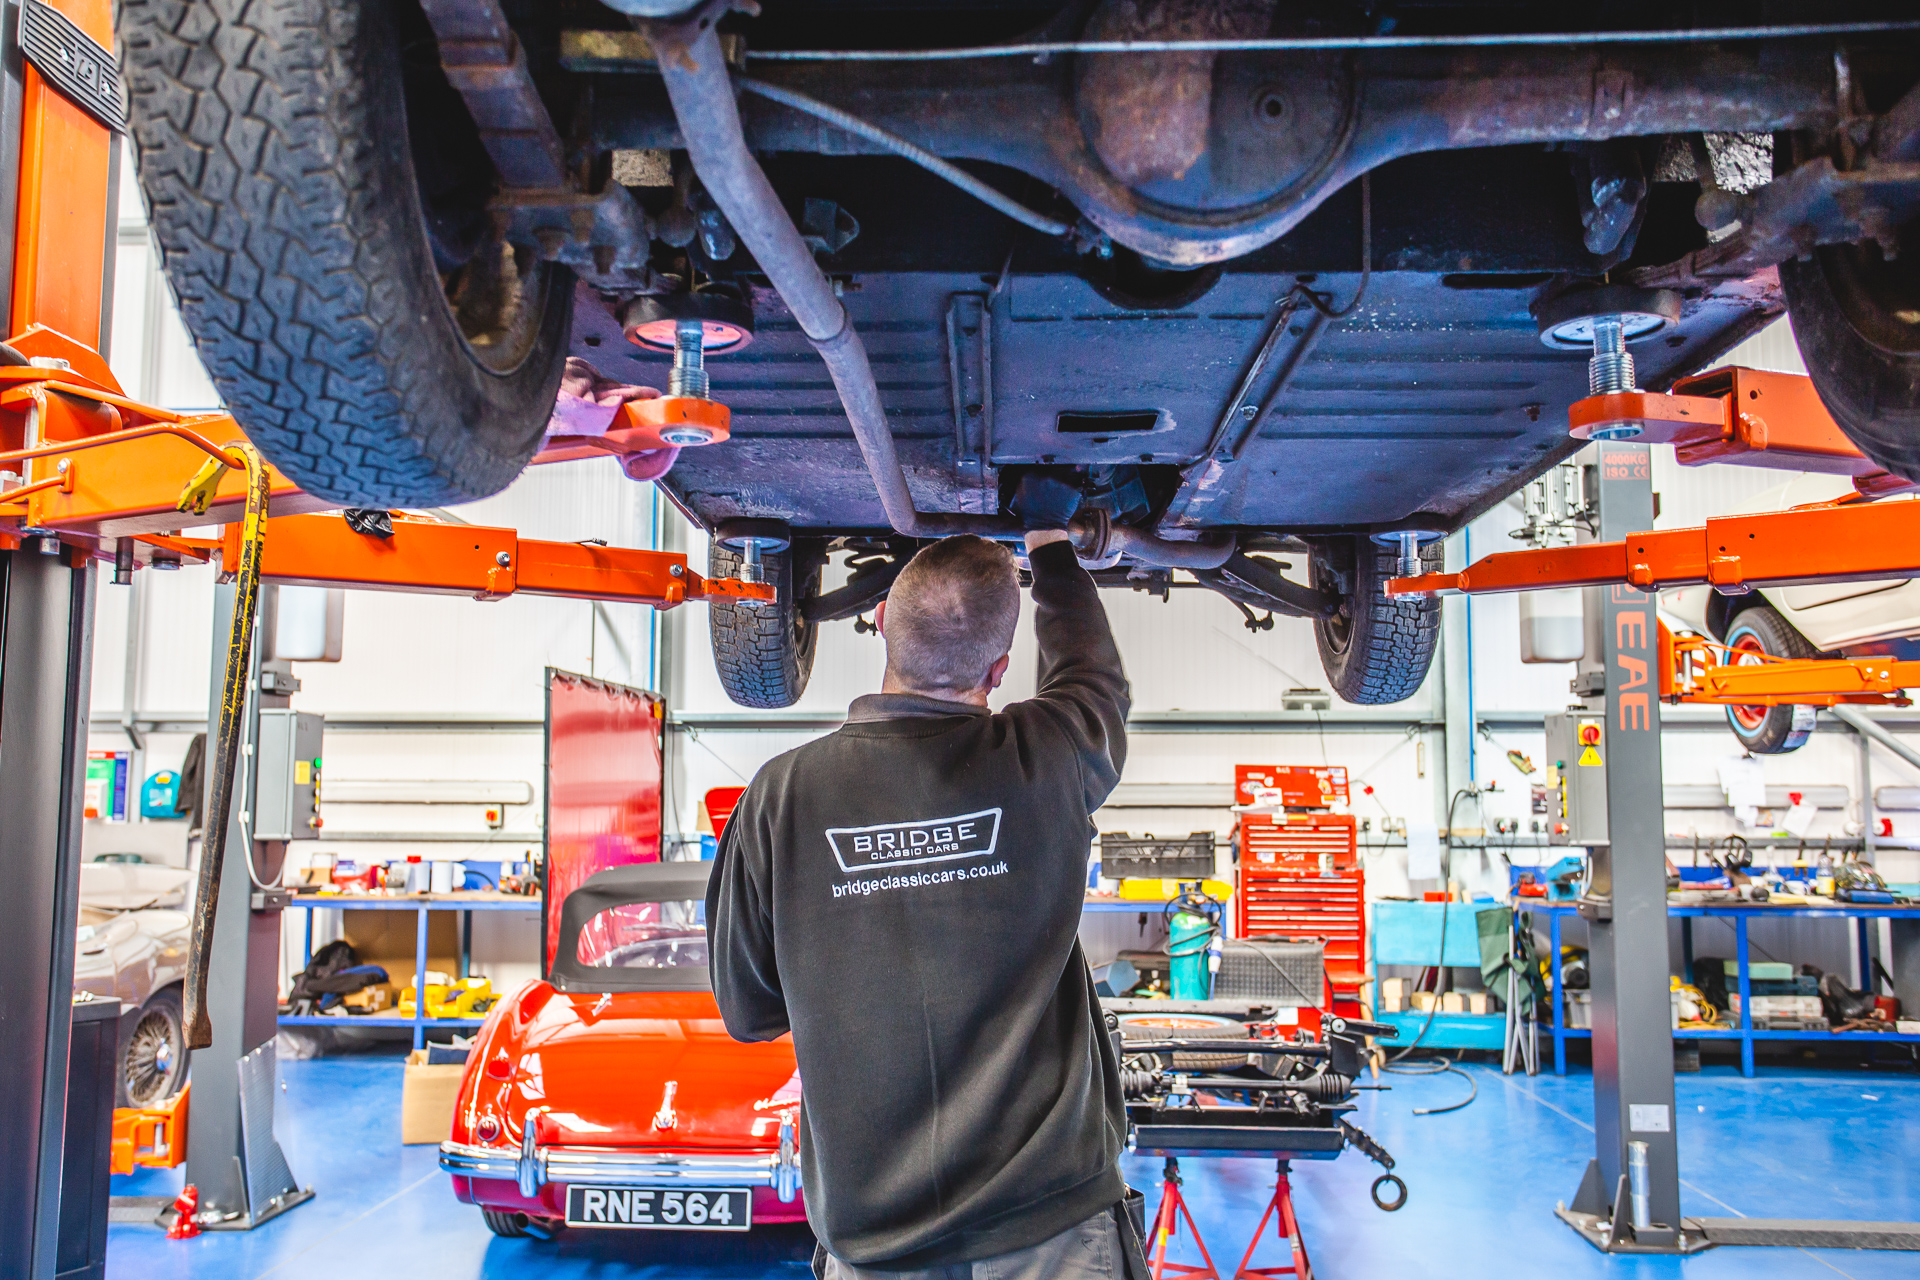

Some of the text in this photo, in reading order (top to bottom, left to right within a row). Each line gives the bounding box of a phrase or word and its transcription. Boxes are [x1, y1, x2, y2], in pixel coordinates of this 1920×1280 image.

[1604, 453, 1647, 466] 4000KG
[1606, 466, 1629, 478] ISO
[1616, 610, 1650, 732] EAE
[853, 822, 977, 853] BRIDGE
[870, 842, 959, 860] CLASSIC CARS
[831, 860, 1009, 898] bridgeclassiccars.co.uk
[583, 1189, 733, 1225] RNE 564
